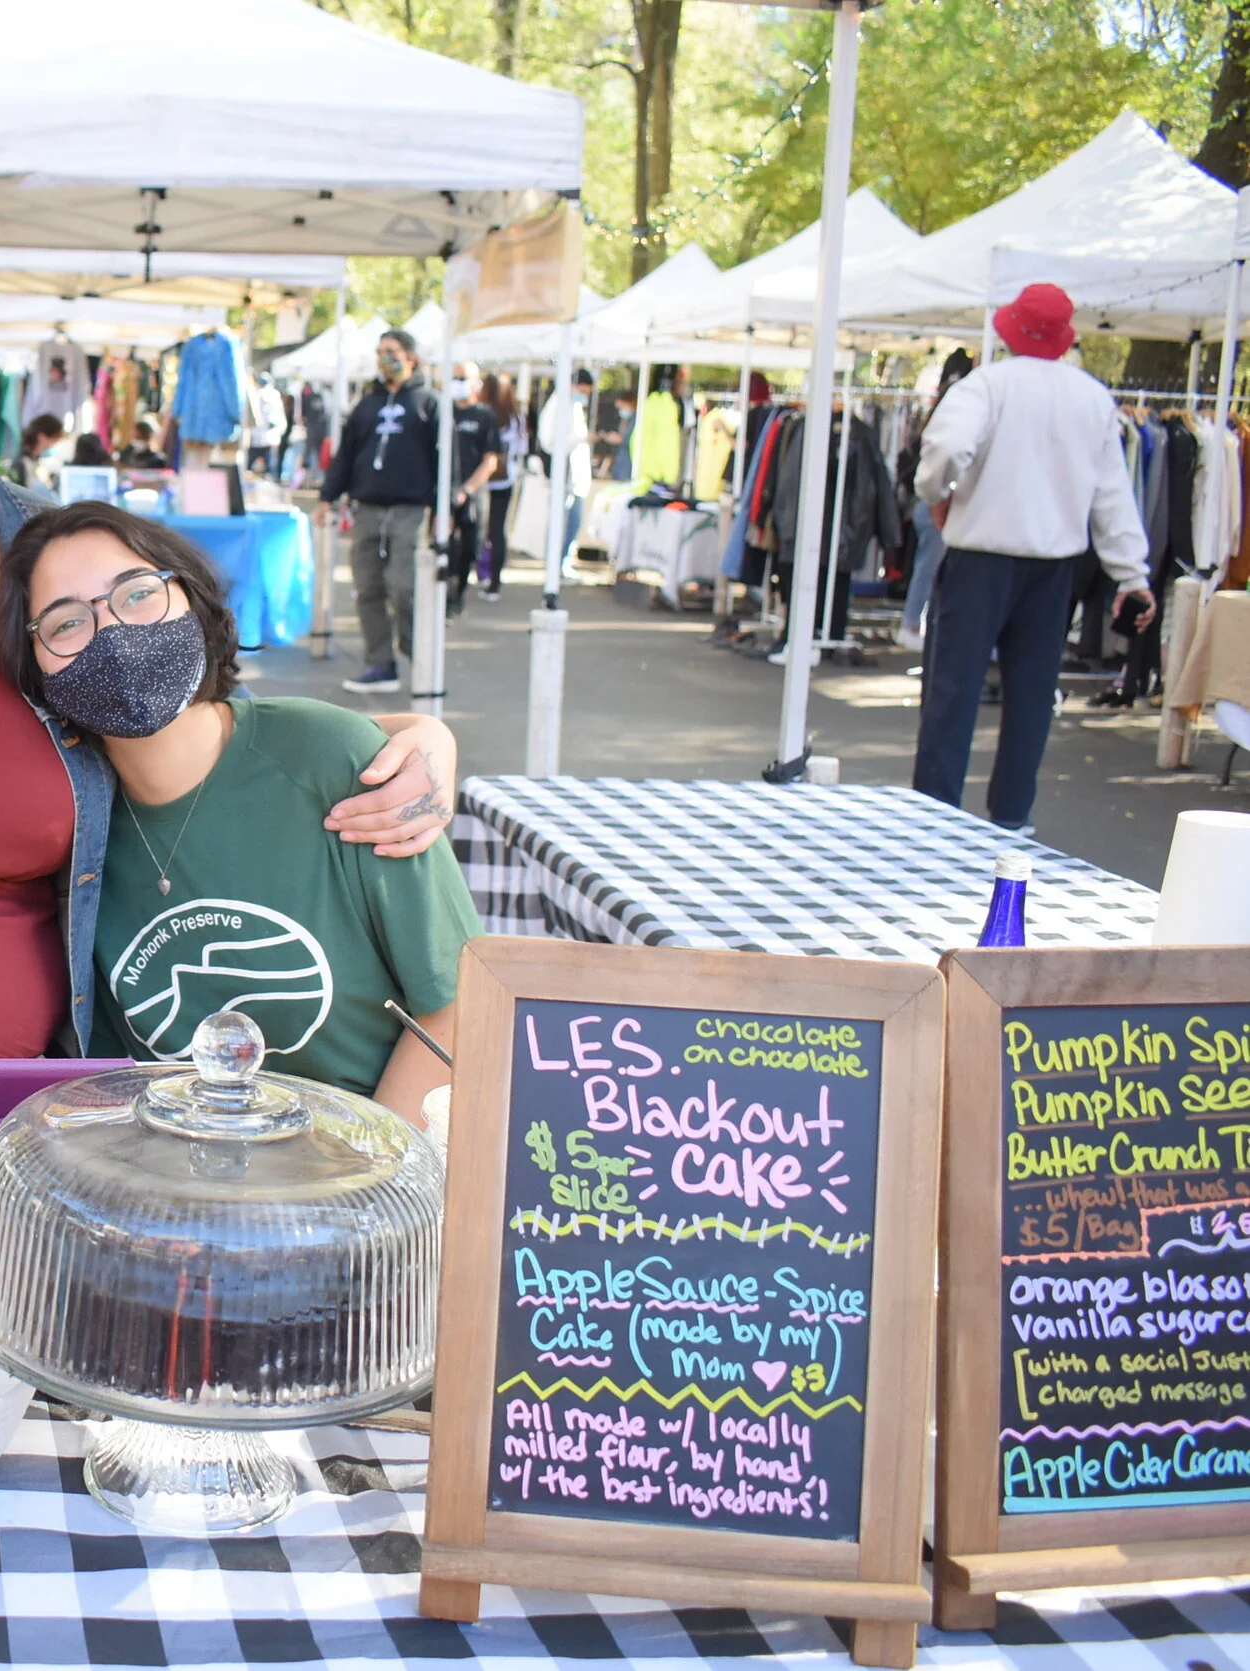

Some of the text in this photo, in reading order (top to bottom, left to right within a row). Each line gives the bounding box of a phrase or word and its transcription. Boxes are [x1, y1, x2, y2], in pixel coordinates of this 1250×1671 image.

[123, 912, 242, 986] Mohonk Preserve
[684, 1044, 869, 1078] on chocolate
[1004, 1020, 1176, 1084] Pumpkin
[584, 1075, 844, 1147] Blackout
[1011, 1075, 1171, 1130] Pumpkin
[1007, 1132, 1107, 1181] Butter
[1109, 1126, 1221, 1175] Crunch
[1009, 1269, 1250, 1314] orange blosso
[733, 1312, 773, 1356] by
[1011, 1307, 1132, 1343] vanilla
[1120, 1348, 1189, 1373] social
[1037, 1380, 1142, 1410] charged
[506, 1400, 812, 1463] All made w/ locally
[500, 1458, 532, 1499] w/
[538, 1464, 589, 1500] the
[601, 1465, 661, 1503] best
[504, 1431, 587, 1462] milled
[689, 1441, 724, 1482] by
